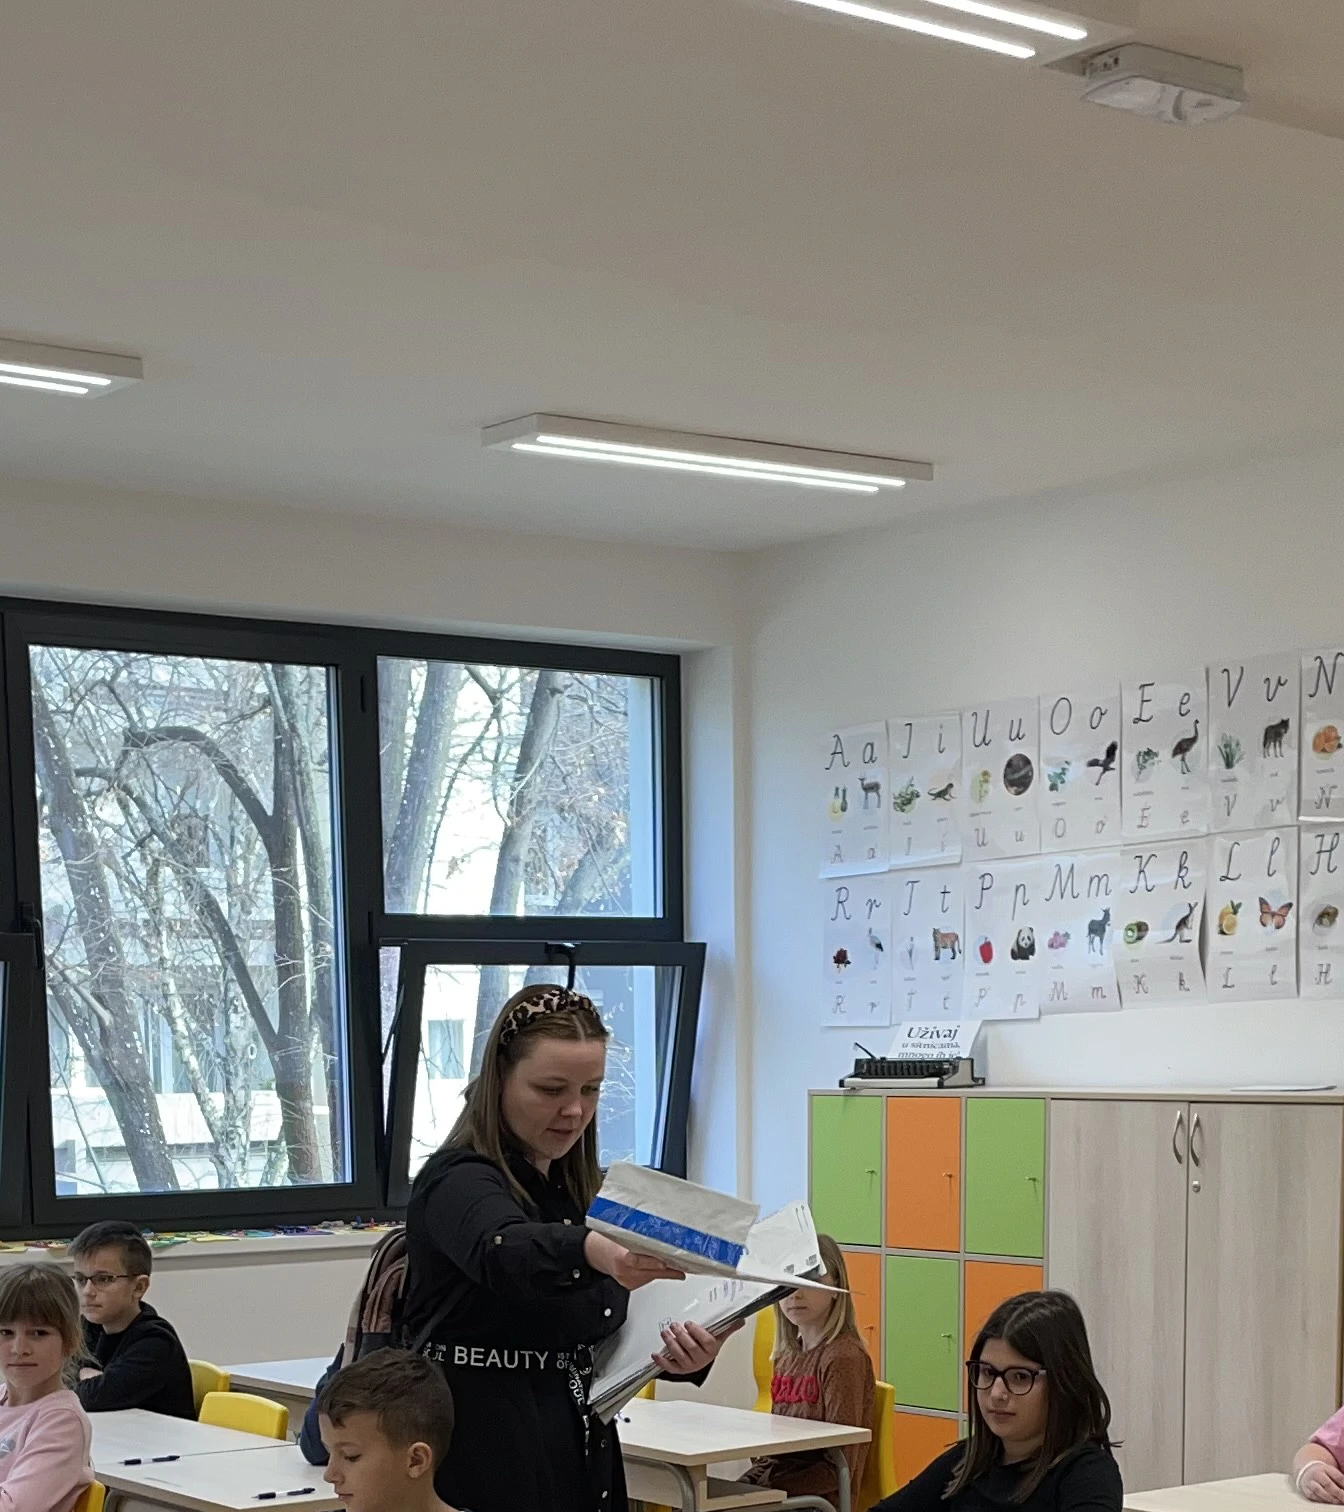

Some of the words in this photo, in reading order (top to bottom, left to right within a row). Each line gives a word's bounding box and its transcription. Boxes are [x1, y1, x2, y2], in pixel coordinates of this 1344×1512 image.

[1221, 666, 1244, 708] V
[1264, 676, 1288, 702] v
[1308, 652, 1344, 698] N
[1050, 697, 1072, 735] O
[1090, 707, 1108, 729] o
[1133, 683, 1154, 724] E
[1179, 693, 1190, 717] e
[938, 724, 946, 754] i
[971, 710, 992, 747] U
[1009, 718, 1025, 741] u
[825, 734, 850, 770] A
[863, 742, 877, 764] a
[1129, 854, 1157, 893] K
[1174, 851, 1192, 889] k
[1220, 842, 1241, 881] L
[1267, 837, 1280, 877] l
[1310, 832, 1339, 875] H
[940, 885, 951, 913] t
[975, 873, 993, 909] P
[1012, 884, 1030, 920] p
[1045, 864, 1079, 901] M
[1087, 874, 1112, 898] m
[831, 887, 851, 921] R
[866, 899, 881, 919] r
[907, 1024, 961, 1041] Uživaj
[454, 1346, 549, 1370] BEAUTY
